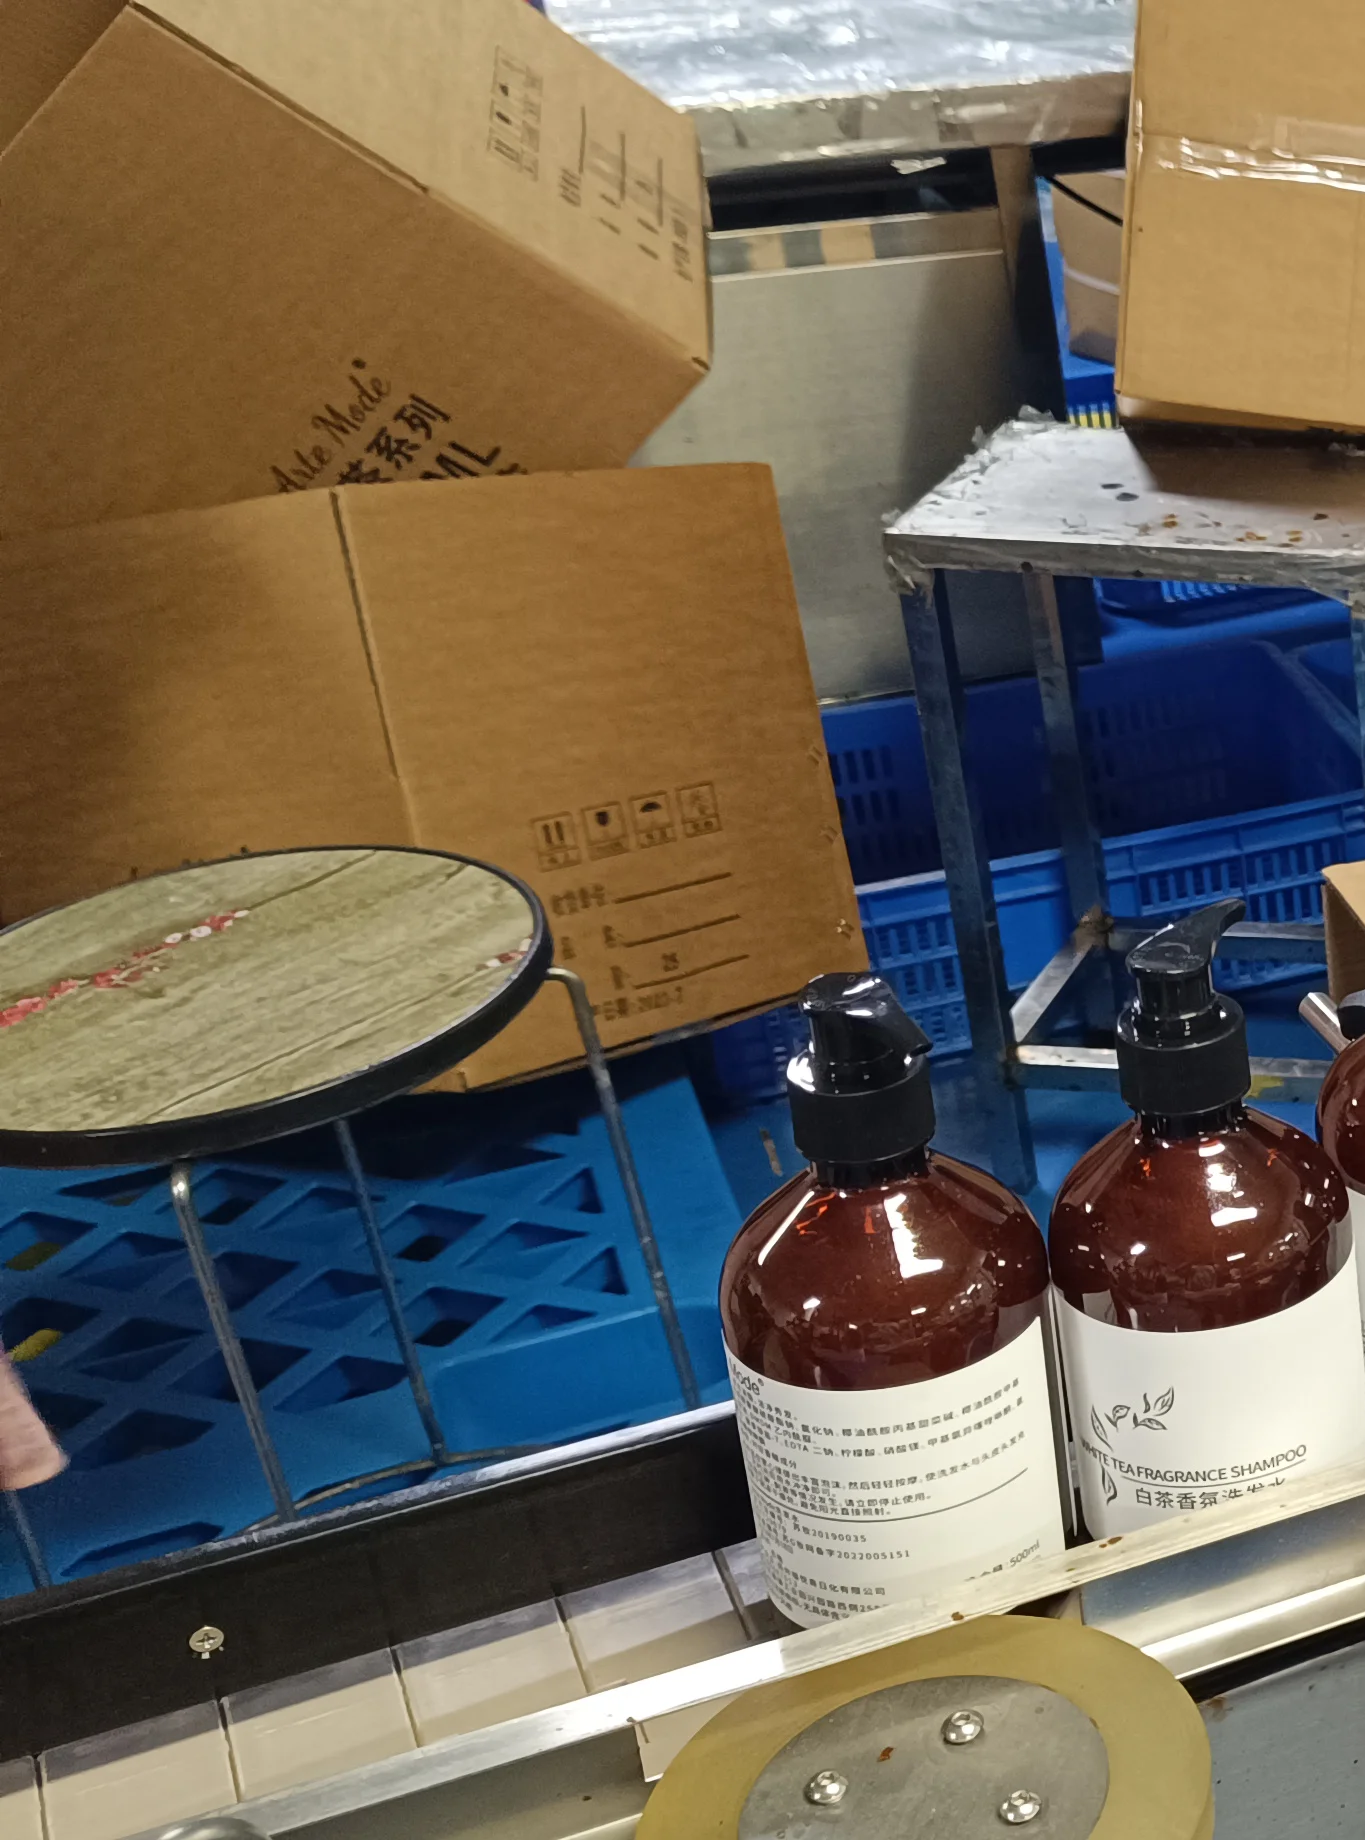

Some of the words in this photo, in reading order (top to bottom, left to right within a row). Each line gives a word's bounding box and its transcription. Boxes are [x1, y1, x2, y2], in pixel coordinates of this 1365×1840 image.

[1081, 1437, 1110, 1467] WHITE
[1110, 1457, 1136, 1478] TEA
[1136, 1464, 1228, 1484] FRAGRANCE
[1231, 1444, 1308, 1478] SHAMPOO
